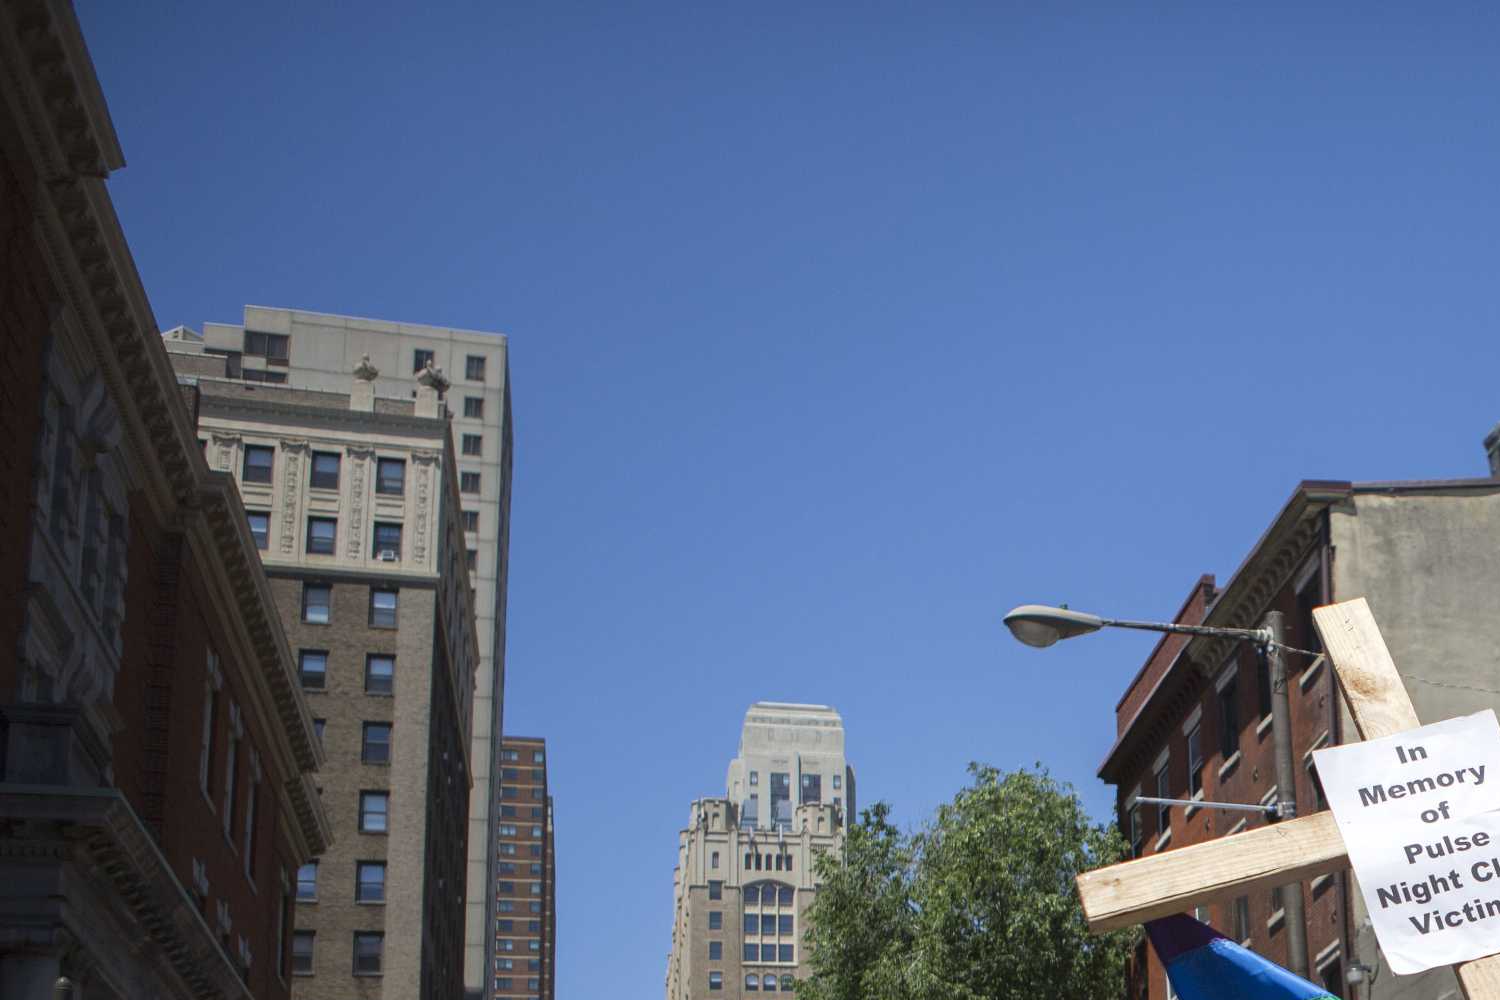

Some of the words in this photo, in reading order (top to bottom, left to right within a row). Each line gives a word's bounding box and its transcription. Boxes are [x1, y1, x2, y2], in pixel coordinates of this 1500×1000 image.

[1396, 743, 1428, 765] In
[1357, 764, 1486, 807] Memory
[1420, 800, 1451, 824] of
[1403, 830, 1490, 865] Pulse
[1375, 868, 1464, 909] Night
